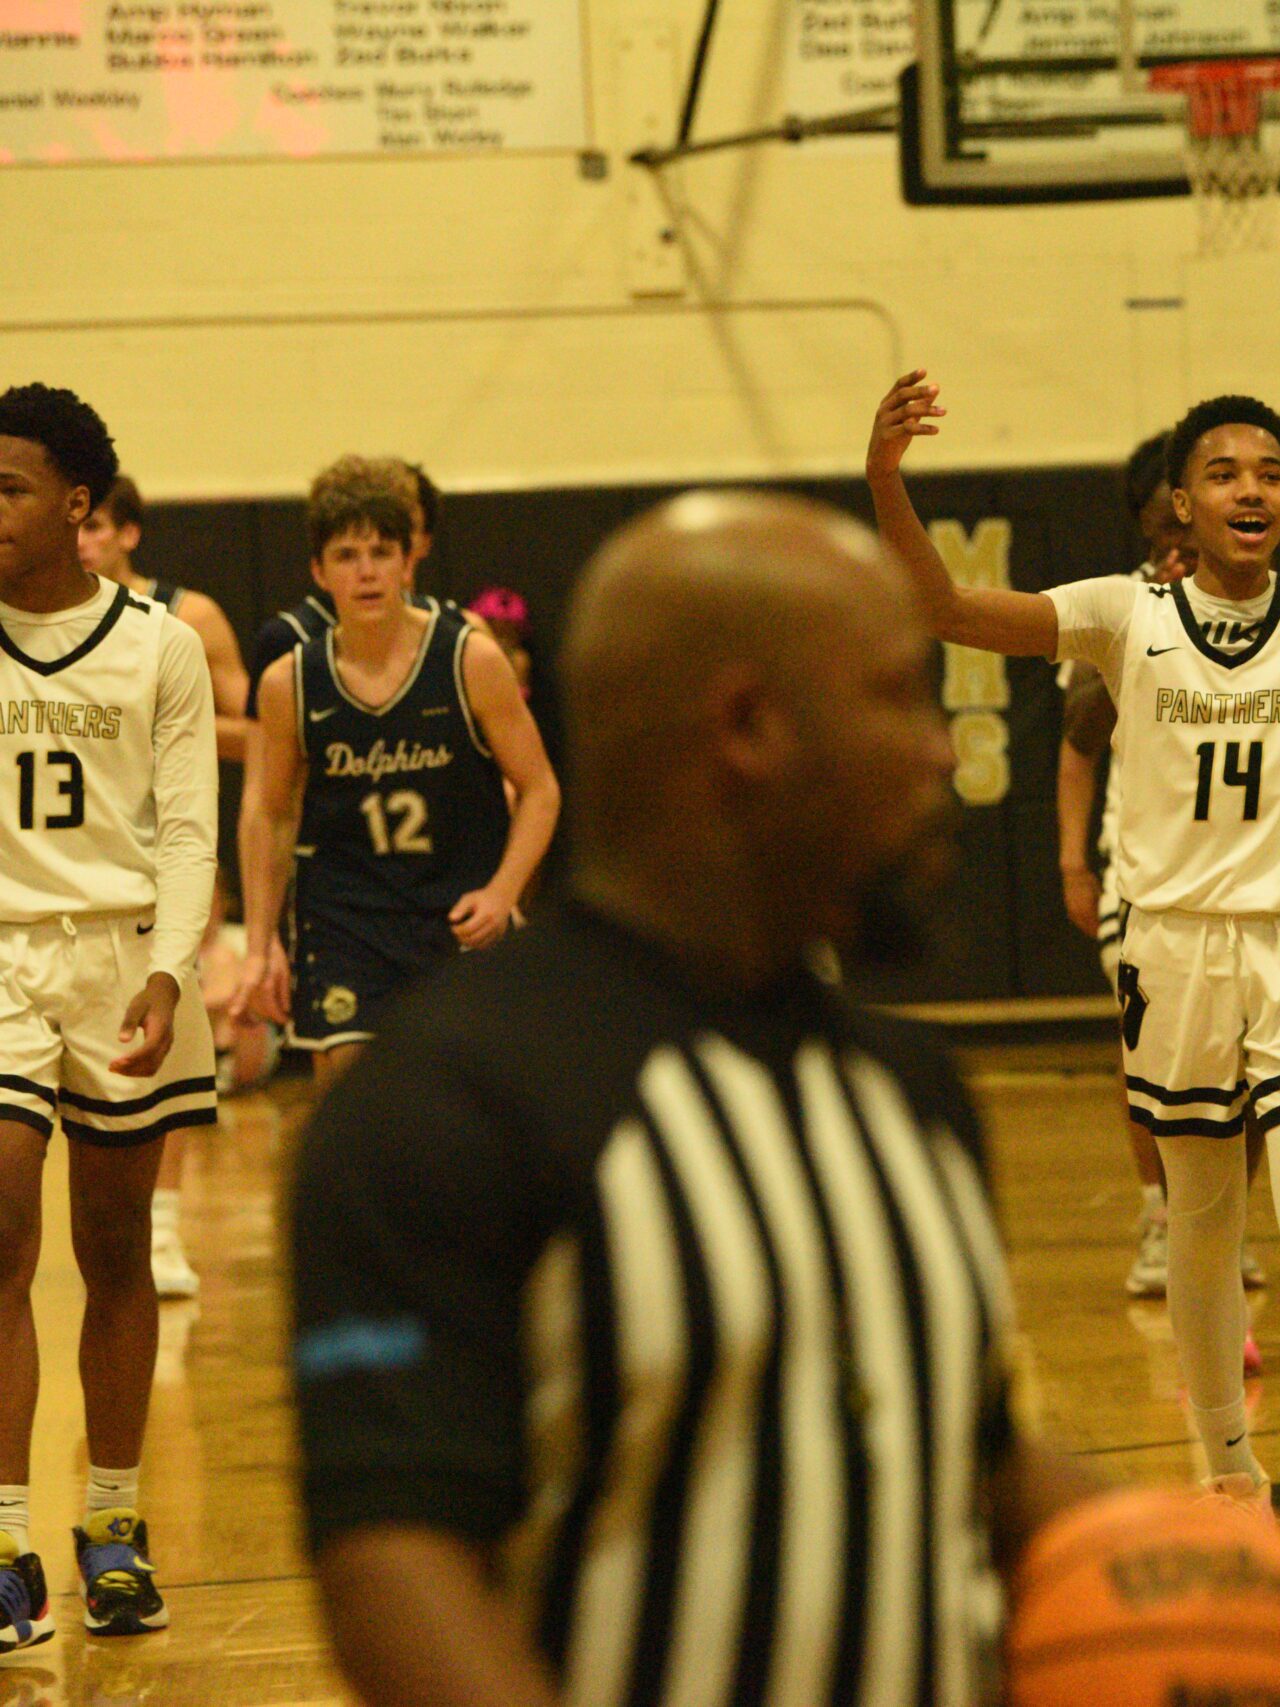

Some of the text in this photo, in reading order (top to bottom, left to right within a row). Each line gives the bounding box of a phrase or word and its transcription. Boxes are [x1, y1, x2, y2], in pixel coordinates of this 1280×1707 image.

[0, 700, 122, 740] NTHERS
[16, 751, 85, 830] 13
[326, 740, 454, 782] Dolphins
[1194, 741, 1263, 821] 14
[361, 789, 433, 855] 12
